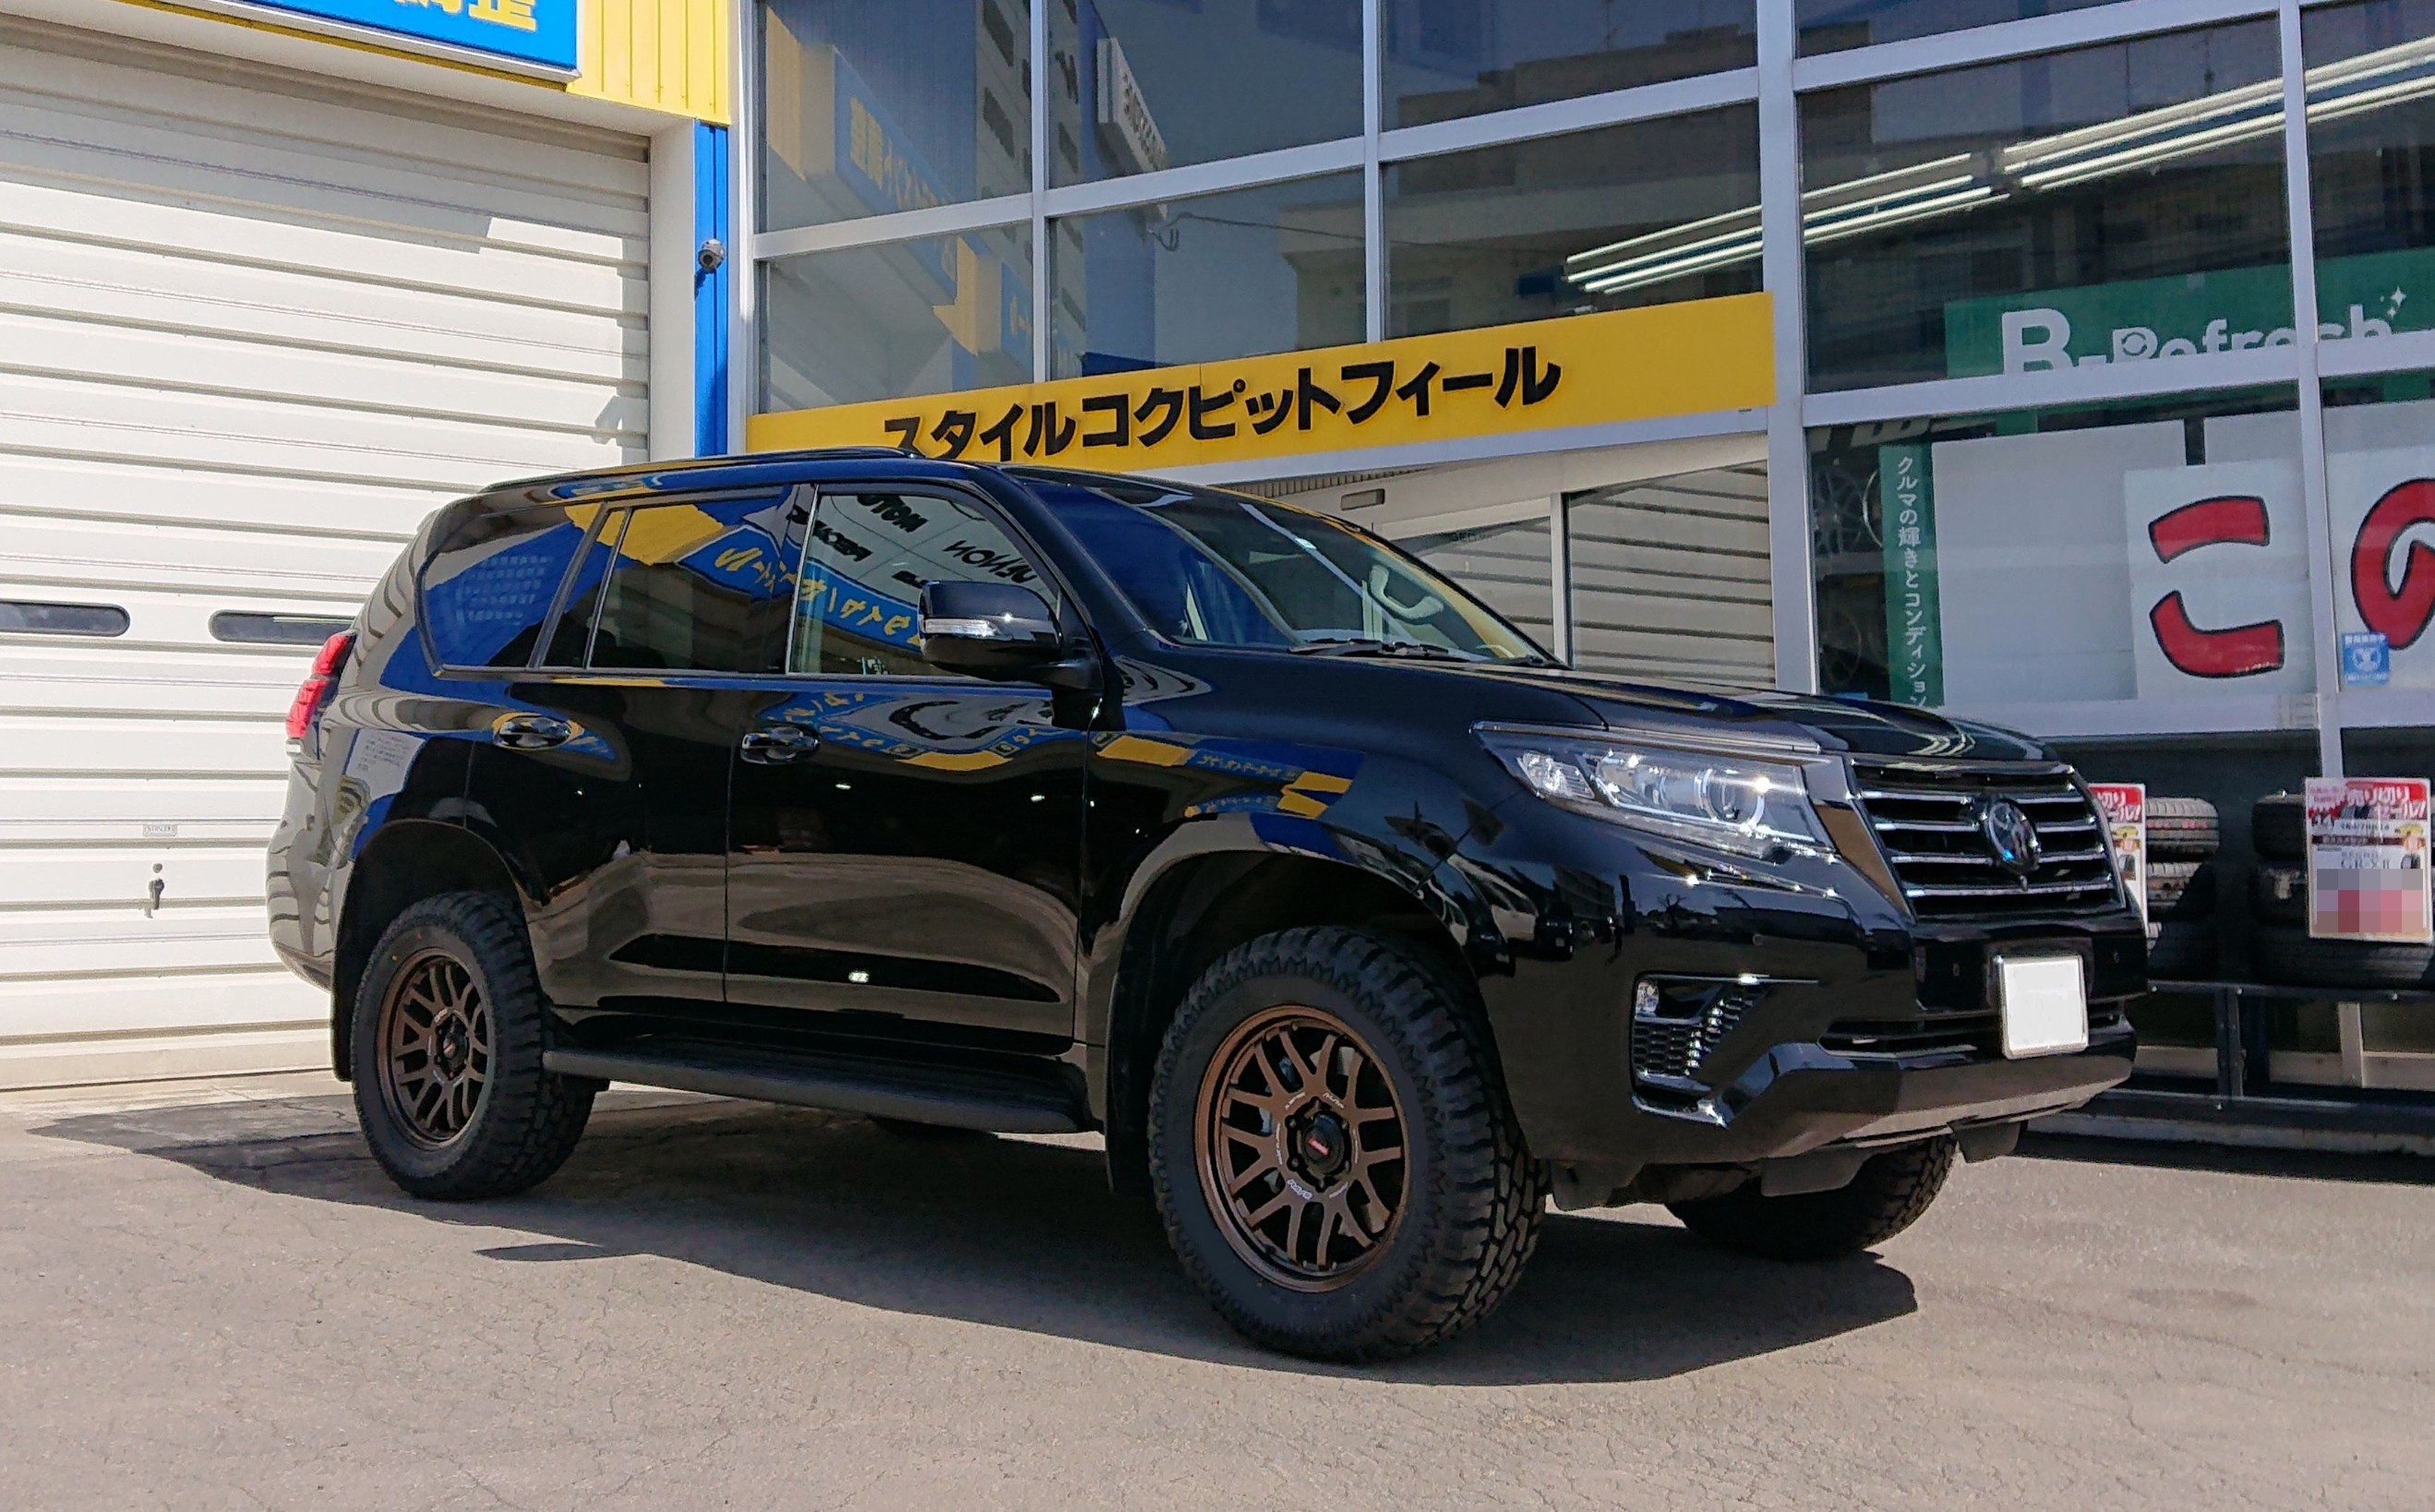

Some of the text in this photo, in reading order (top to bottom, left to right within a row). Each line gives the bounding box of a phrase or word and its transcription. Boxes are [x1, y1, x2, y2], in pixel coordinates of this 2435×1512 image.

[884, 345, 1562, 462] スタイルコクピットフィール
[1895, 456, 1928, 707] クルマの輝きとコンディション
